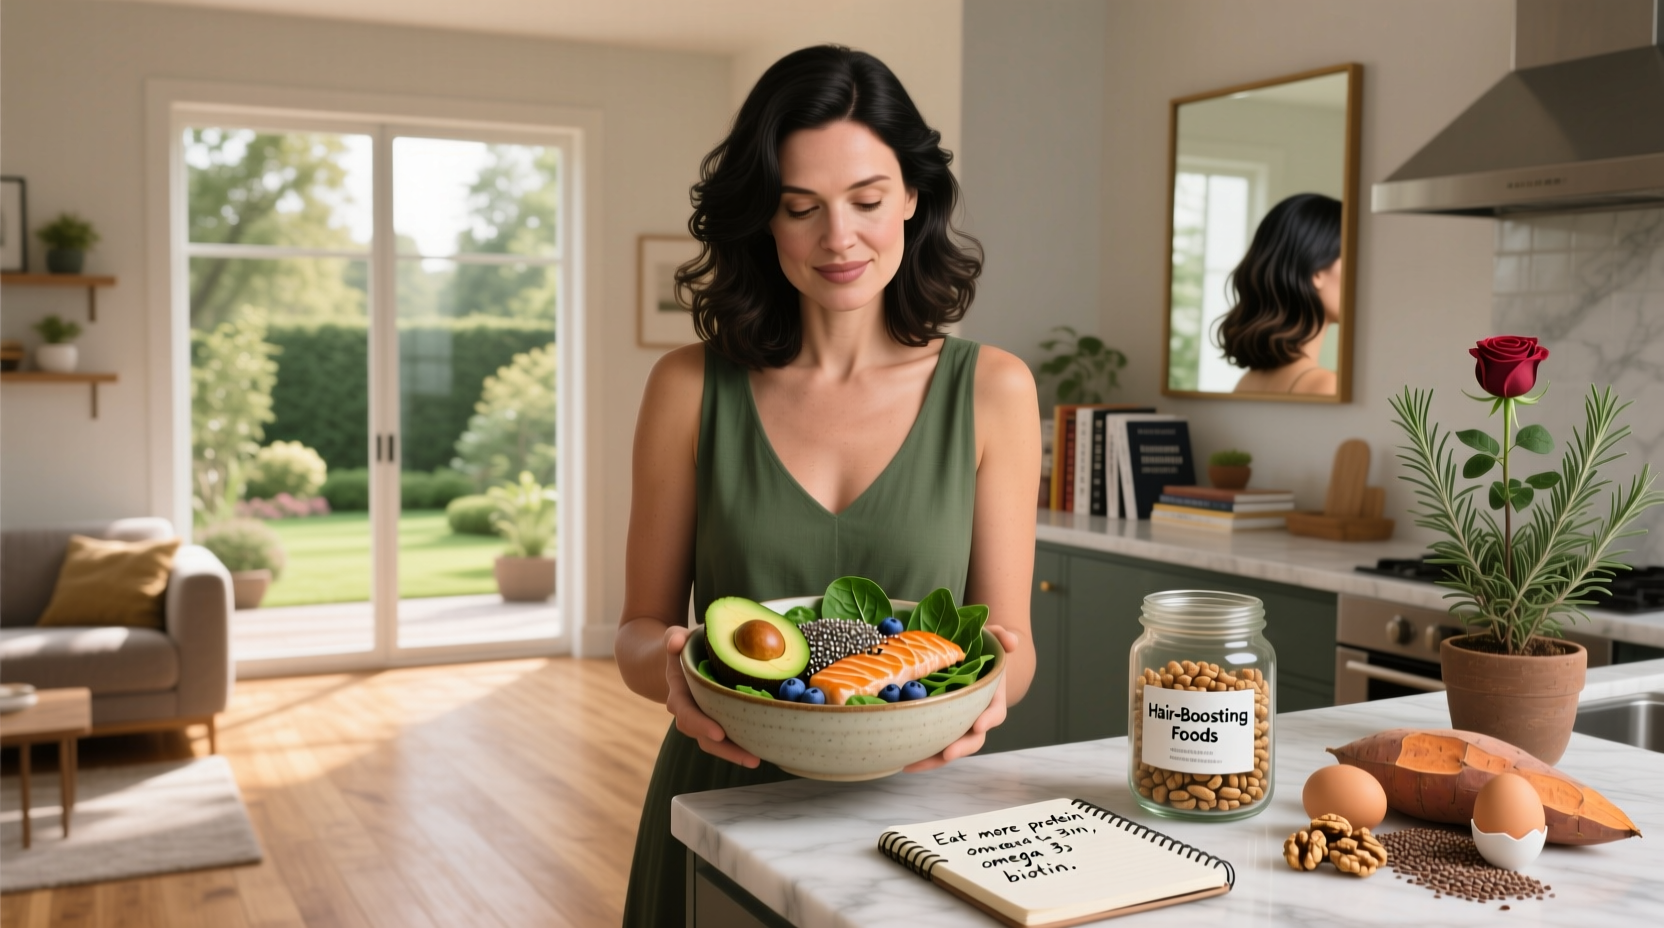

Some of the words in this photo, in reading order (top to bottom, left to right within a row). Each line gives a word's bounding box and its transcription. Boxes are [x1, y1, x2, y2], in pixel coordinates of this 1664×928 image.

[1148, 702, 1248, 726] Hair-Boosting
[1171, 726, 1219, 743] Foods
[932, 830, 968, 846] Eat
[978, 824, 1021, 839] more
[1028, 812, 1085, 834] protein
[982, 850, 1044, 869] omega
[1003, 862, 1077, 883] biotin.
